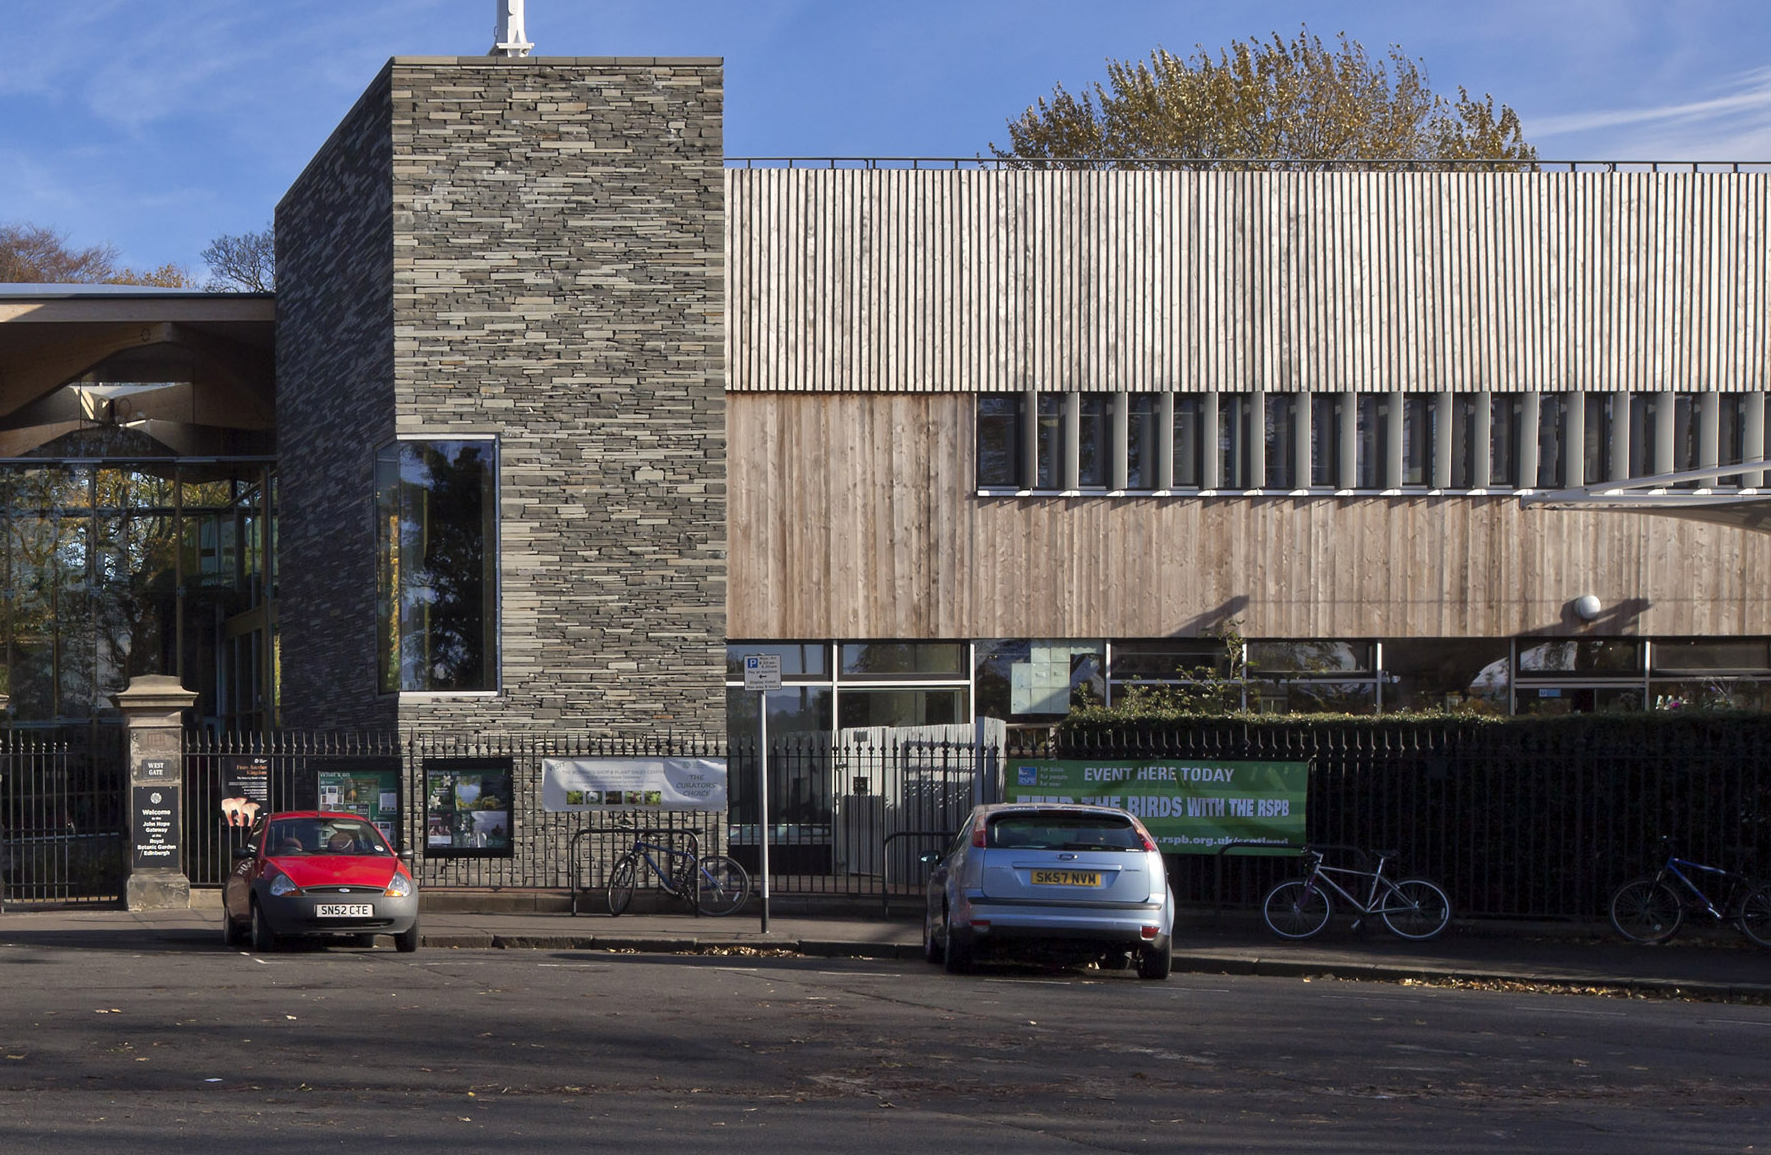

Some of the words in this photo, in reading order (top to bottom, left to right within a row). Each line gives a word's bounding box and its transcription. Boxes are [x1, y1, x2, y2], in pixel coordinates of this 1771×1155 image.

[750, 659, 756, 667] P
[548, 762, 565, 772] VISIT
[1084, 768, 1133, 781] EVENT
[1137, 767, 1176, 780] HERE
[1181, 768, 1235, 782] TODAY
[1128, 796, 1182, 817] BIRDS
[1187, 797, 1226, 817] WITH
[1228, 799, 1253, 817] THE
[1258, 800, 1290, 817] RSPB
[1037, 872, 1068, 883] SK57
[1072, 873, 1096, 884] NVM
[321, 906, 346, 915] SN52
[350, 906, 368, 915] CTE
